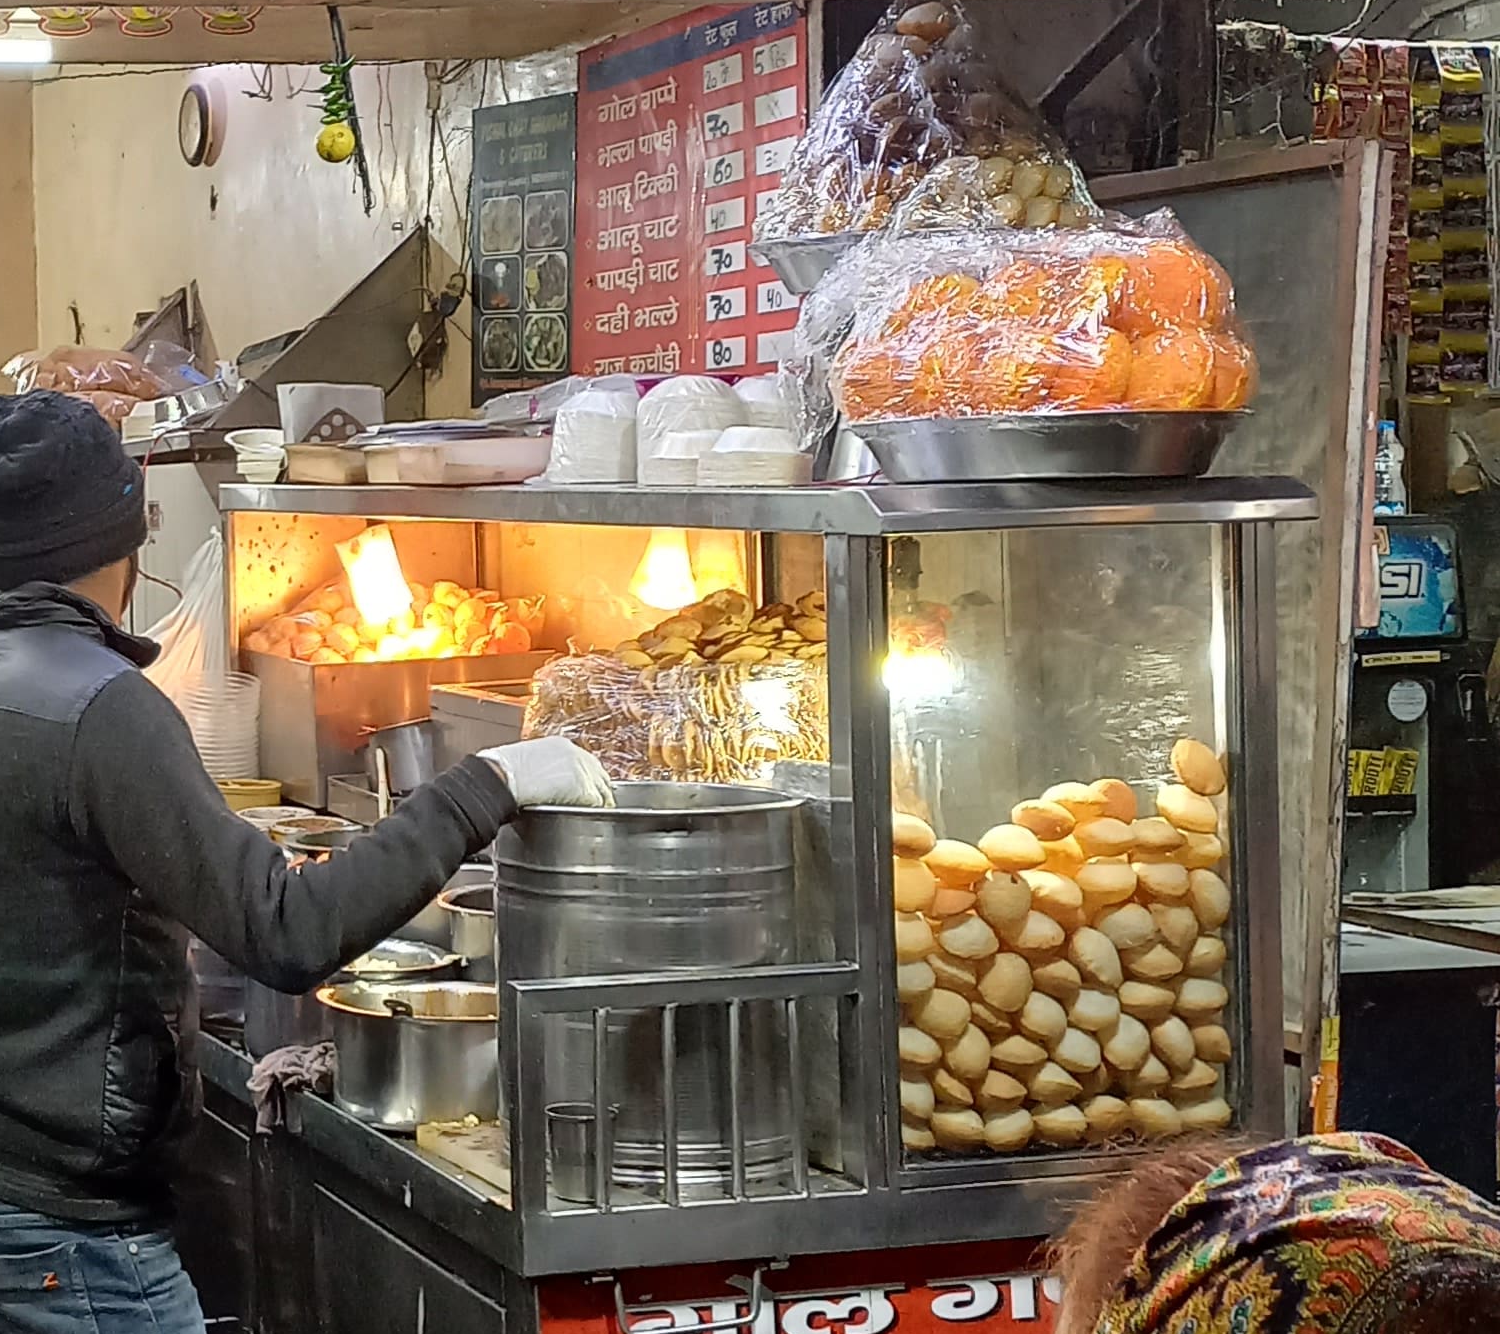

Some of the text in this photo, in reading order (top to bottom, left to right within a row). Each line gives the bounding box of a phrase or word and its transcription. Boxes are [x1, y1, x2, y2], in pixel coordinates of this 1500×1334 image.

[598, 76, 678, 123] गोल गप्पे
[706, 113, 730, 139] 70
[598, 139, 635, 168] भल्ला
[597, 163, 679, 214] आलू टिक्की
[597, 214, 681, 255] आलू चाट
[648, 259, 680, 283] चाट
[710, 248, 732, 275] 70
[595, 295, 680, 334] दही भल्ले
[709, 294, 732, 321] 70
